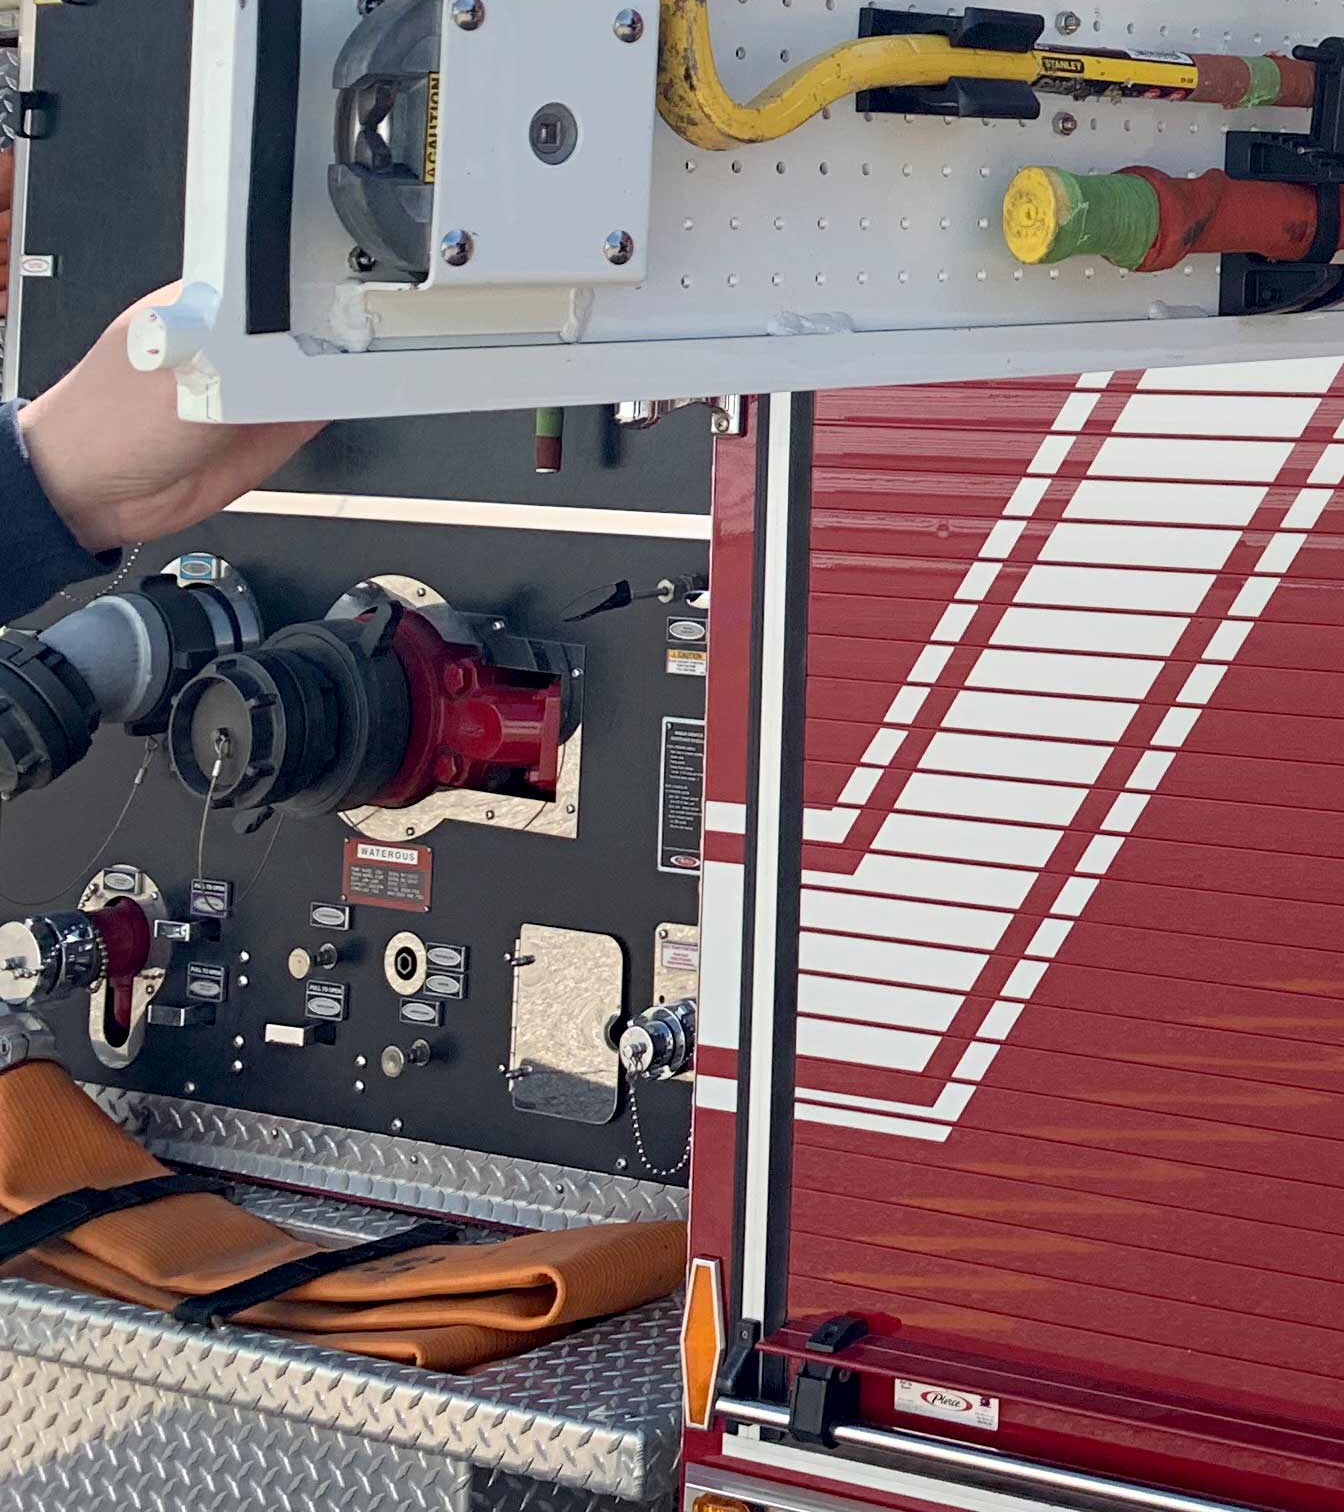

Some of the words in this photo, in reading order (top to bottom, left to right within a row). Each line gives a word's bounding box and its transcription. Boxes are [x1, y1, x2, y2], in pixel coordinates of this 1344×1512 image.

[1044, 58, 1082, 71] STANLEY
[360, 847, 415, 862] WATEROUS
[931, 1392, 961, 1408] Pierce
